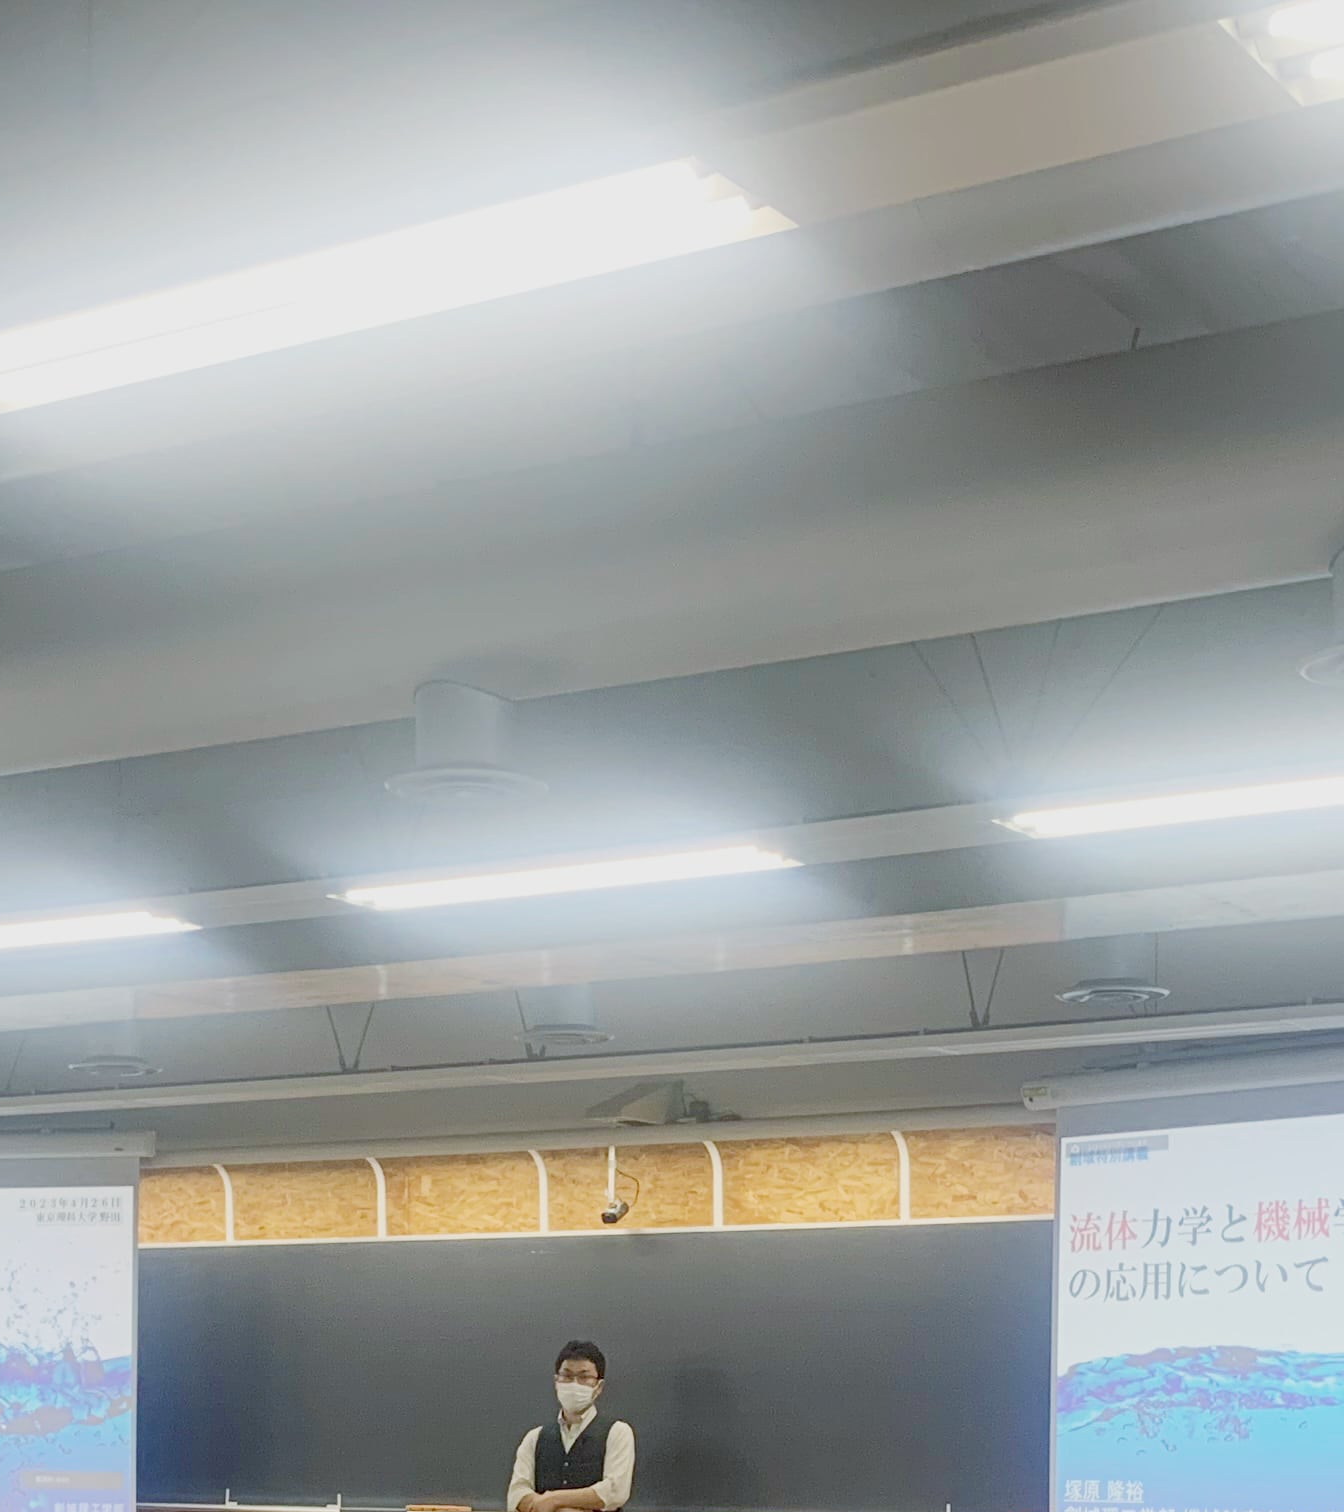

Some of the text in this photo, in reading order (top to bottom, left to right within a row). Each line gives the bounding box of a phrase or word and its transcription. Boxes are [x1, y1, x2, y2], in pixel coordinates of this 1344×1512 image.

[1069, 1255, 1329, 1304] の応用について
